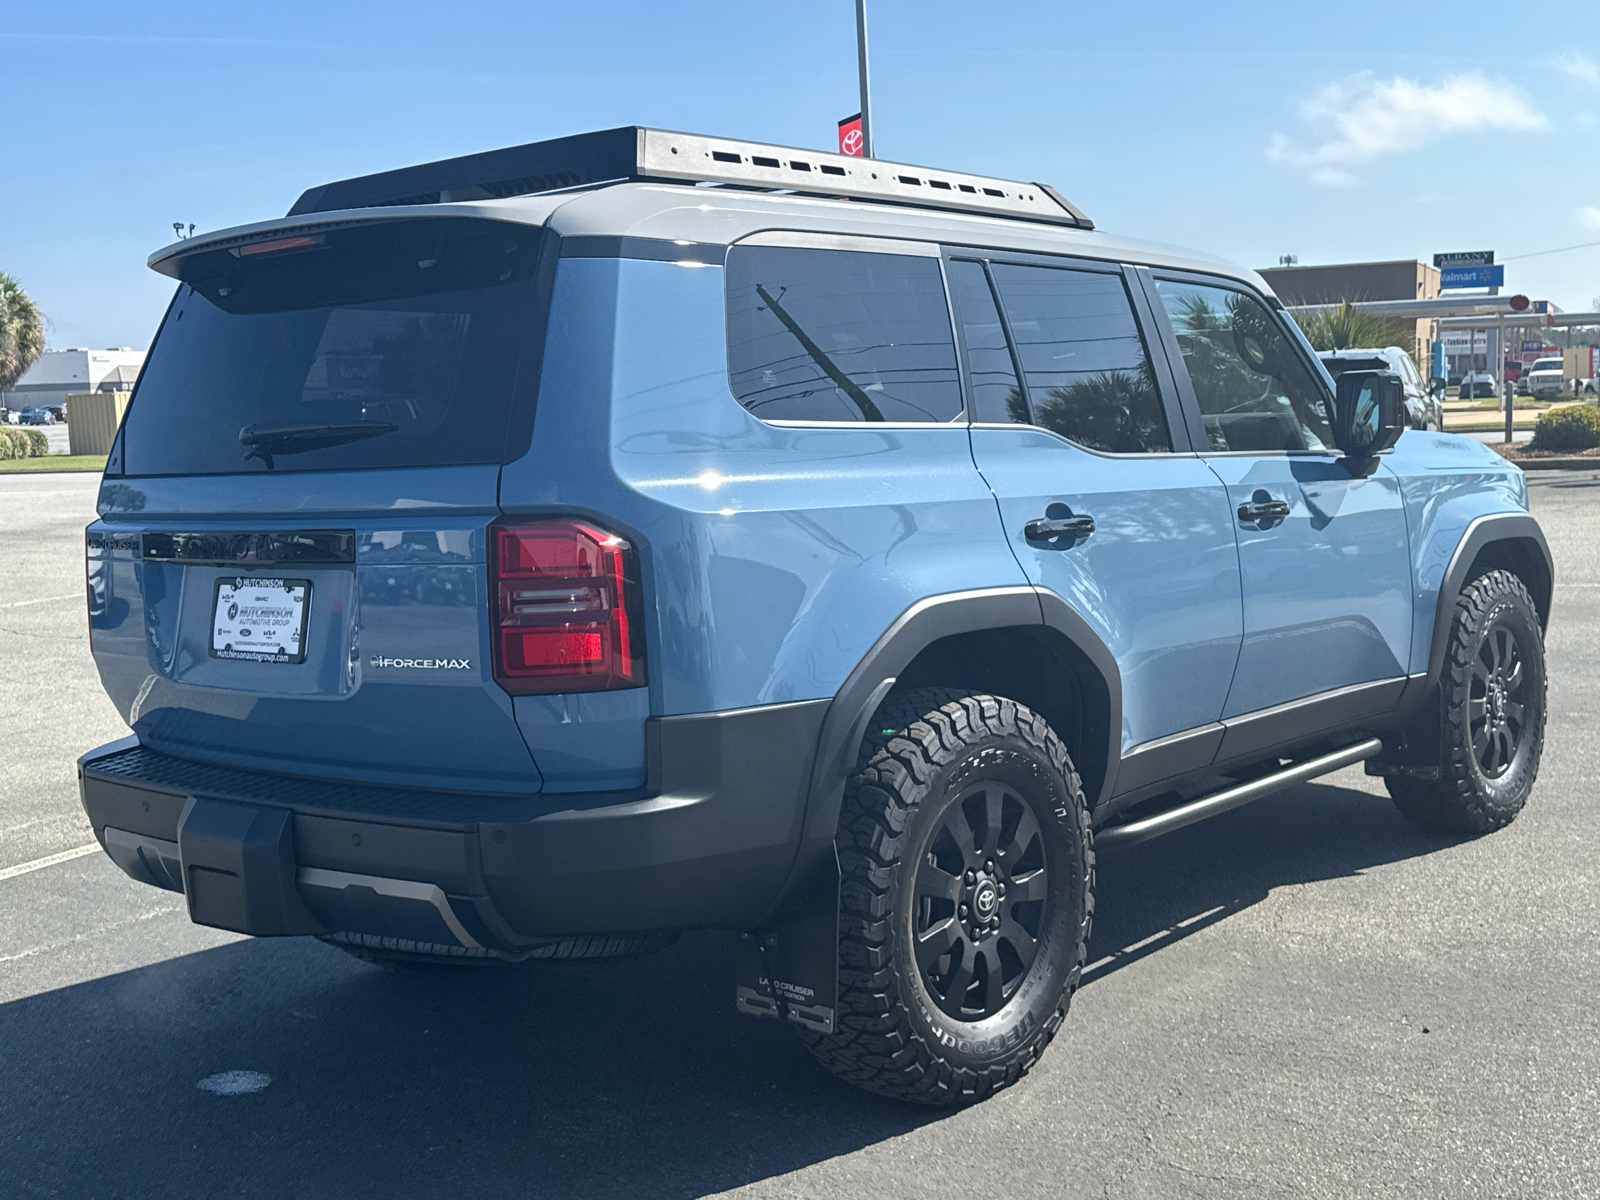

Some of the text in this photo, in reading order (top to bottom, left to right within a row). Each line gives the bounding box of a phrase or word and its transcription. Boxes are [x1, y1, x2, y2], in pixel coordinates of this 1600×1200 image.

[1438, 252, 1489, 261] ALBANY
[105, 539, 140, 551] CRUISER
[243, 578, 285, 588] HUTCHINSON
[239, 606, 295, 618] HUTCHINSON
[239, 618, 291, 627] AUTOMOTIVE GROUP
[216, 649, 289, 663] Hutchinsonautogroup.com
[759, 976, 814, 997] LAD CRUISER
[784, 990, 805, 1001] EDITION
